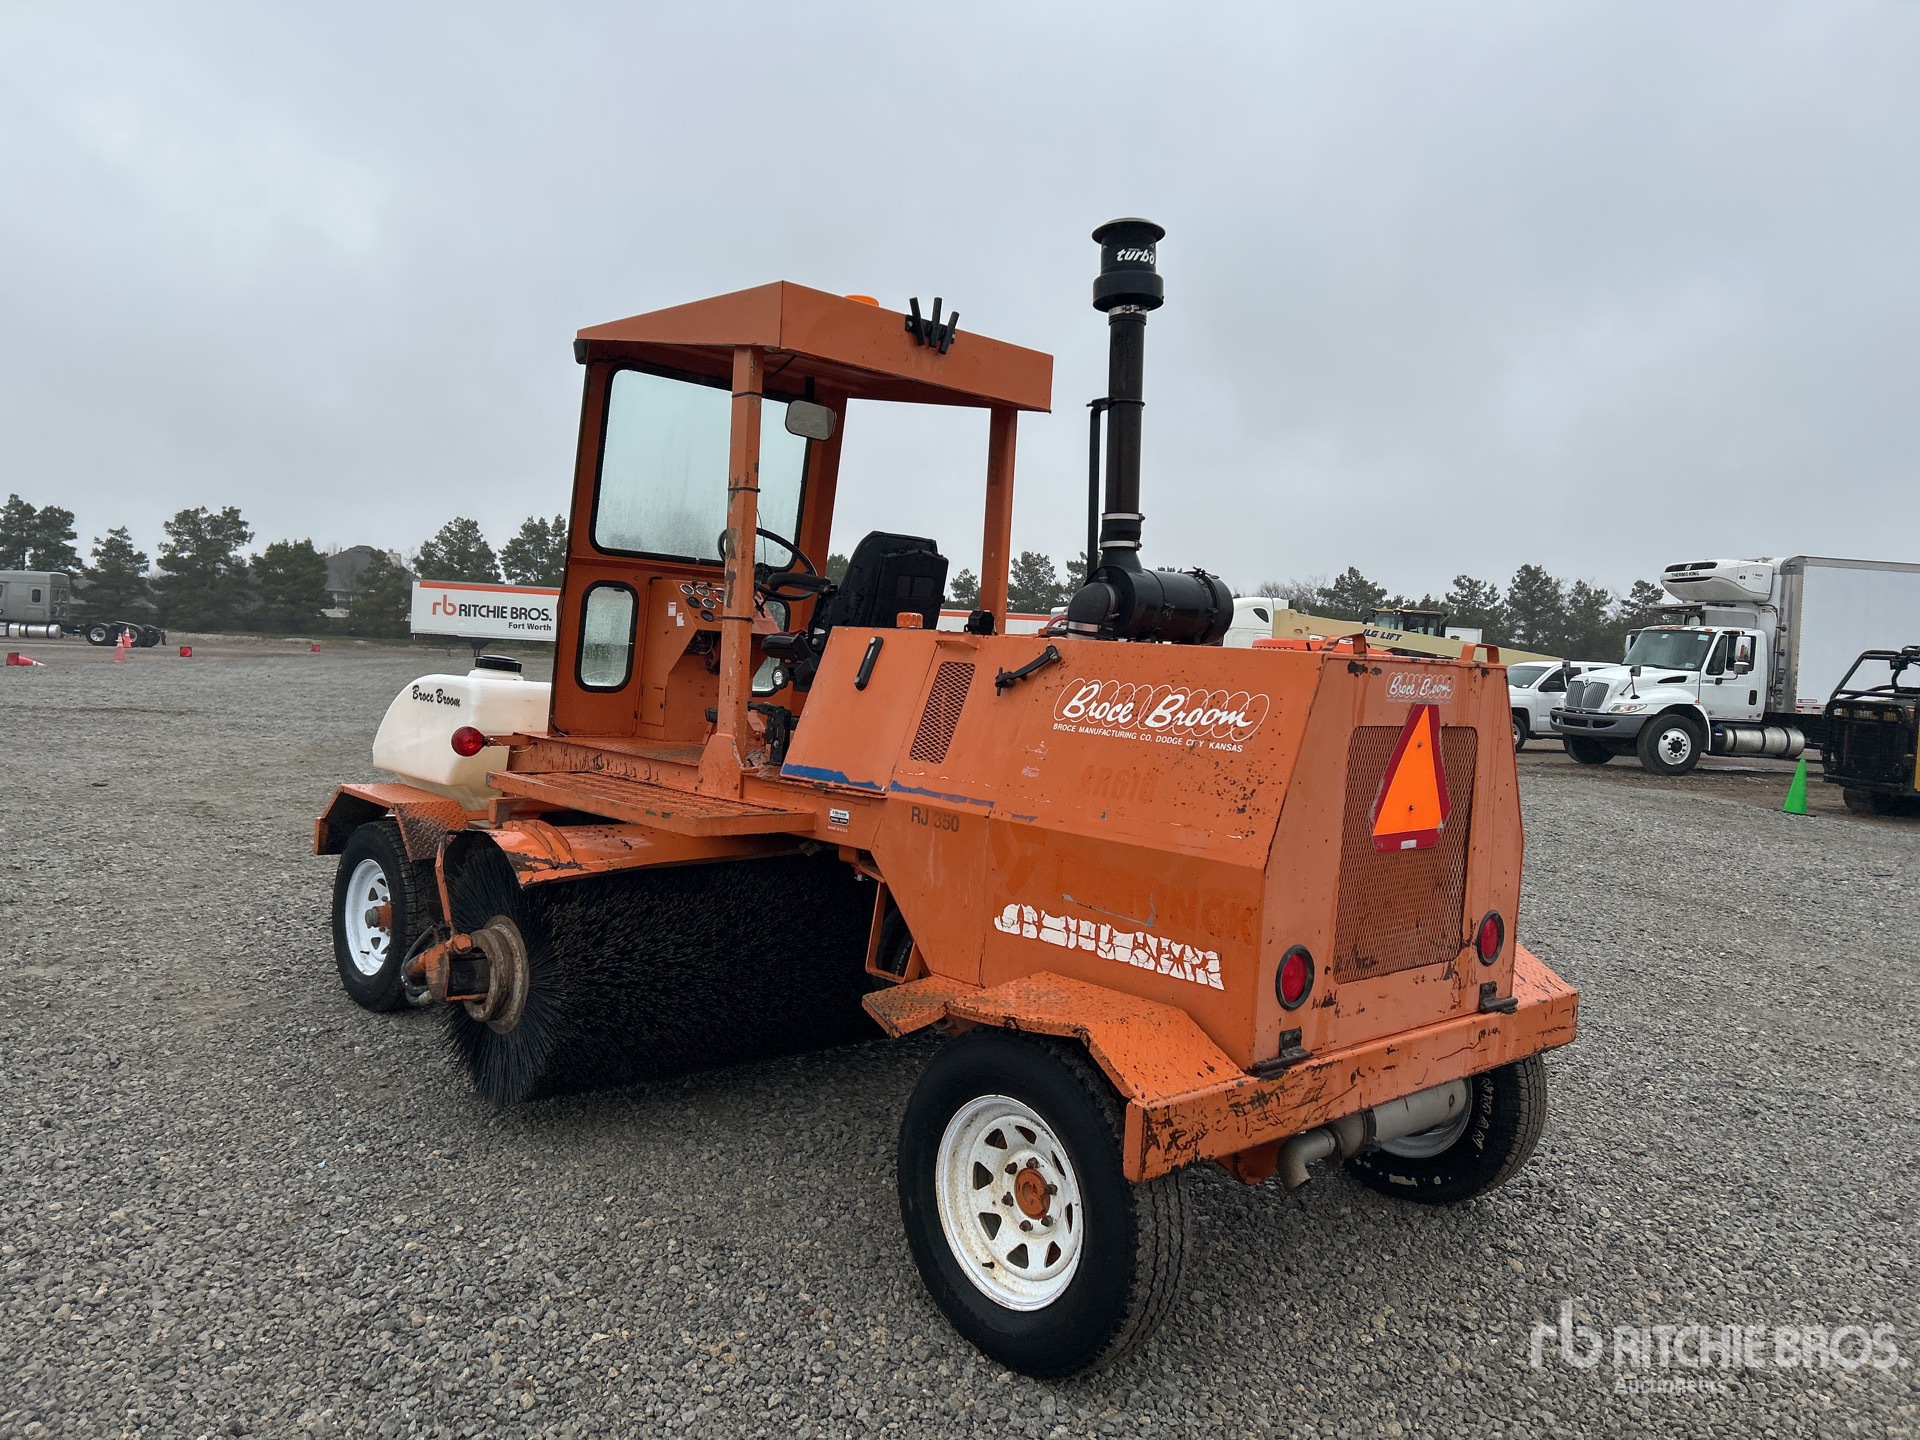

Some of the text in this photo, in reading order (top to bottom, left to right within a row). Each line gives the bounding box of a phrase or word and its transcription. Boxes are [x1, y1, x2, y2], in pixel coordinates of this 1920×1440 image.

[458, 604, 508, 618] RITCHIE
[510, 607, 552, 621] BROS.
[508, 621, 552, 631] Fort Worth
[1380, 631, 1402, 641] LIFT
[1389, 674, 1415, 695] Broce
[412, 685, 461, 707] Broce Broom
[1063, 683, 1254, 728] Broce Broom
[1053, 723, 1077, 733] BROCE
[1078, 726, 1137, 740] MANUFACTURING
[1139, 733, 1153, 742] CO.
[1155, 735, 1183, 746] DODGE
[1208, 741, 1244, 753] KANSAS
[911, 805, 960, 833] RJ 350
